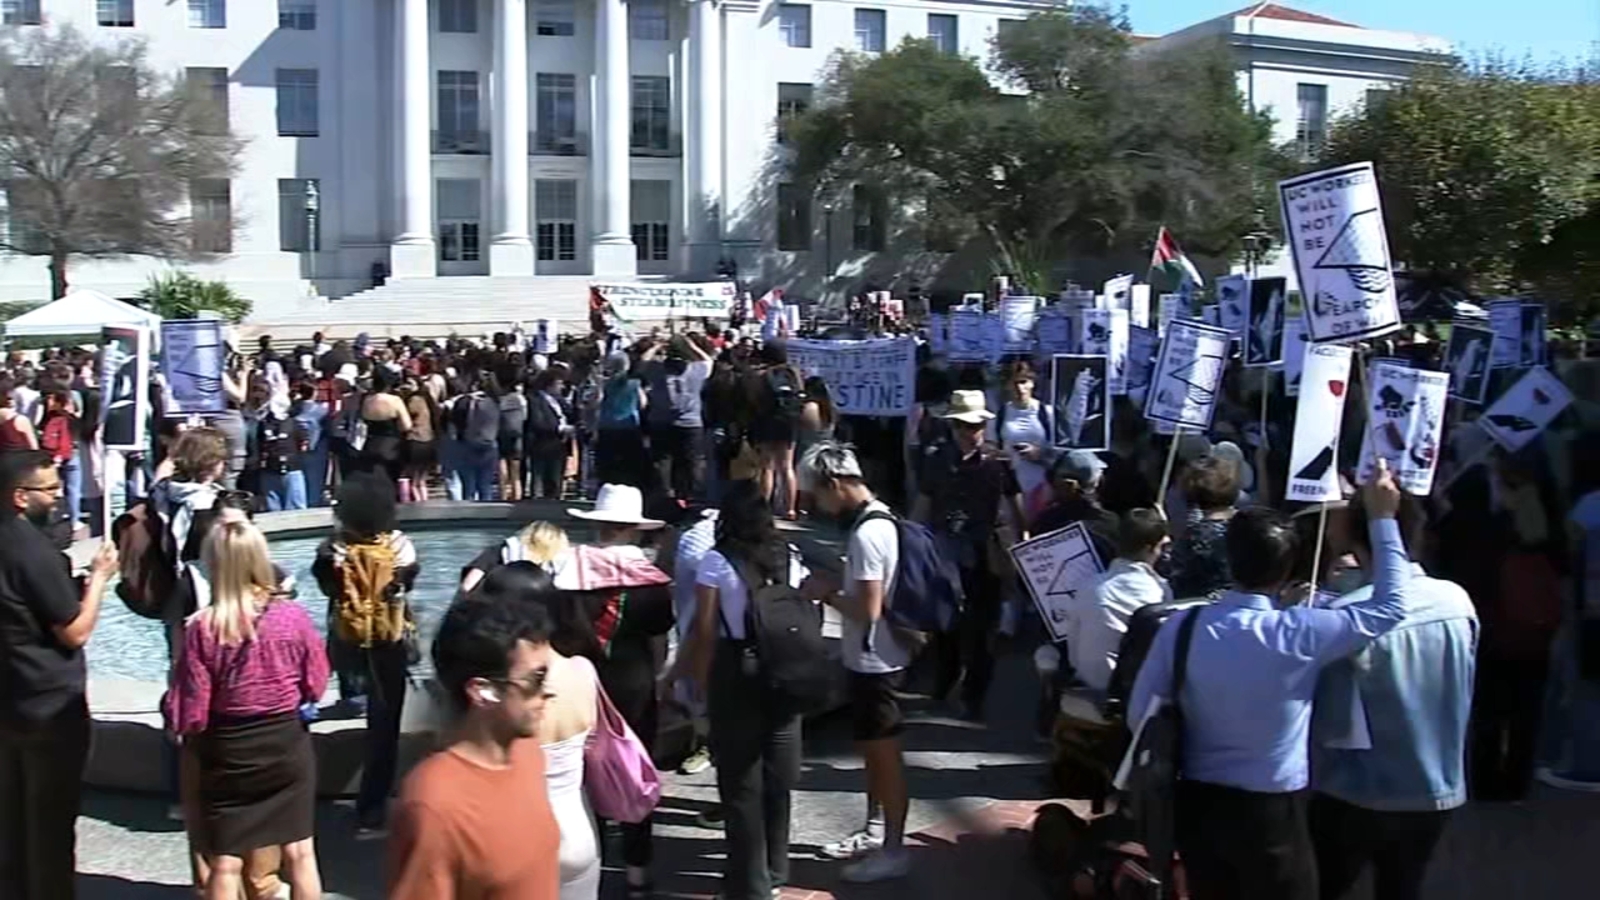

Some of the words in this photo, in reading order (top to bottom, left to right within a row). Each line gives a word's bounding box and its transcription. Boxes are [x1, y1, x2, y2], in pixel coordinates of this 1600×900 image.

[1288, 187, 1307, 200] UC
[1296, 198, 1337, 213] WILL
[1300, 215, 1335, 231] NOT
[1303, 236, 1326, 250] BE
[1332, 320, 1352, 334] OF
